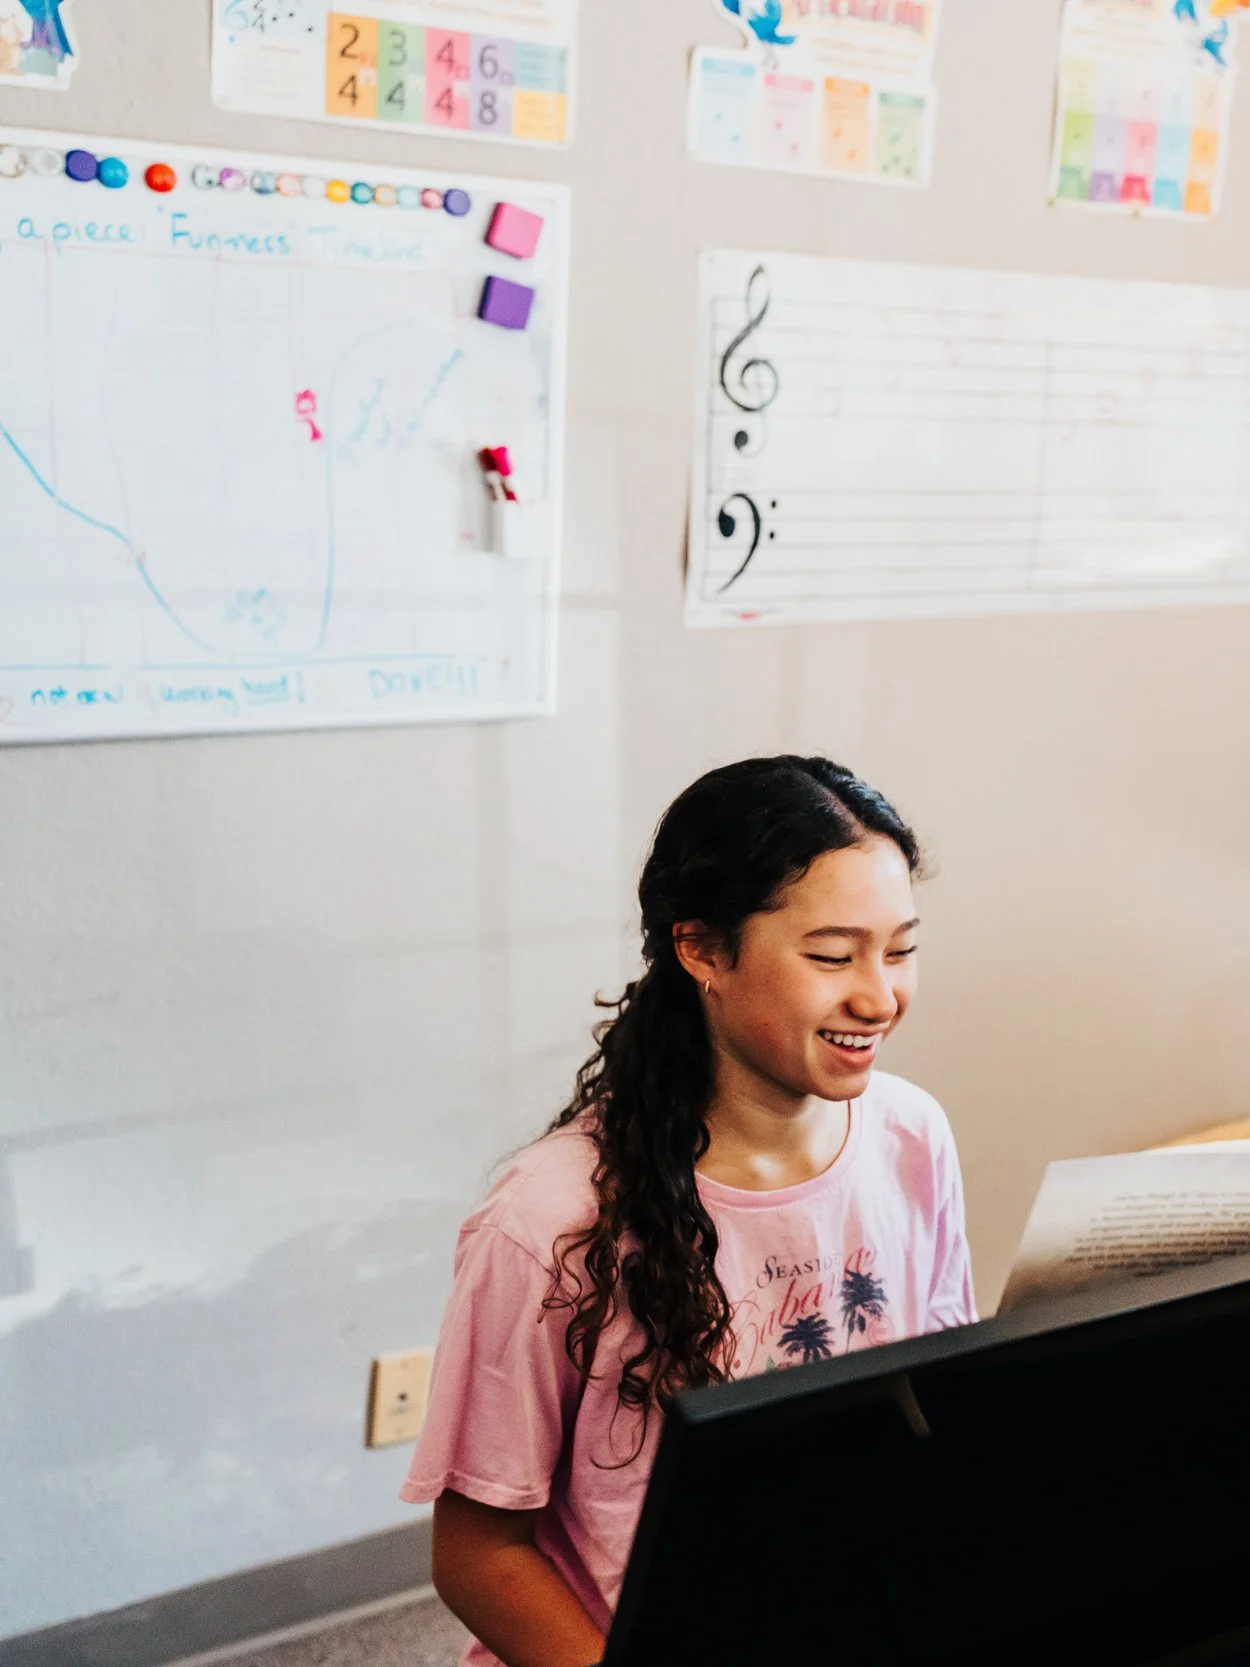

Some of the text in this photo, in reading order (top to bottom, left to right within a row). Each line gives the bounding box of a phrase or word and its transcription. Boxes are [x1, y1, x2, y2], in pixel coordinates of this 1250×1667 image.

[339, 23, 361, 59] 2
[388, 29, 408, 67] 3
[435, 37, 455, 75] 4
[479, 44, 499, 79] 6
[338, 74, 359, 107] 4
[386, 81, 405, 112] 4
[434, 87, 455, 120] 4
[478, 92, 498, 126] 8
[17, 218, 43, 240] a
